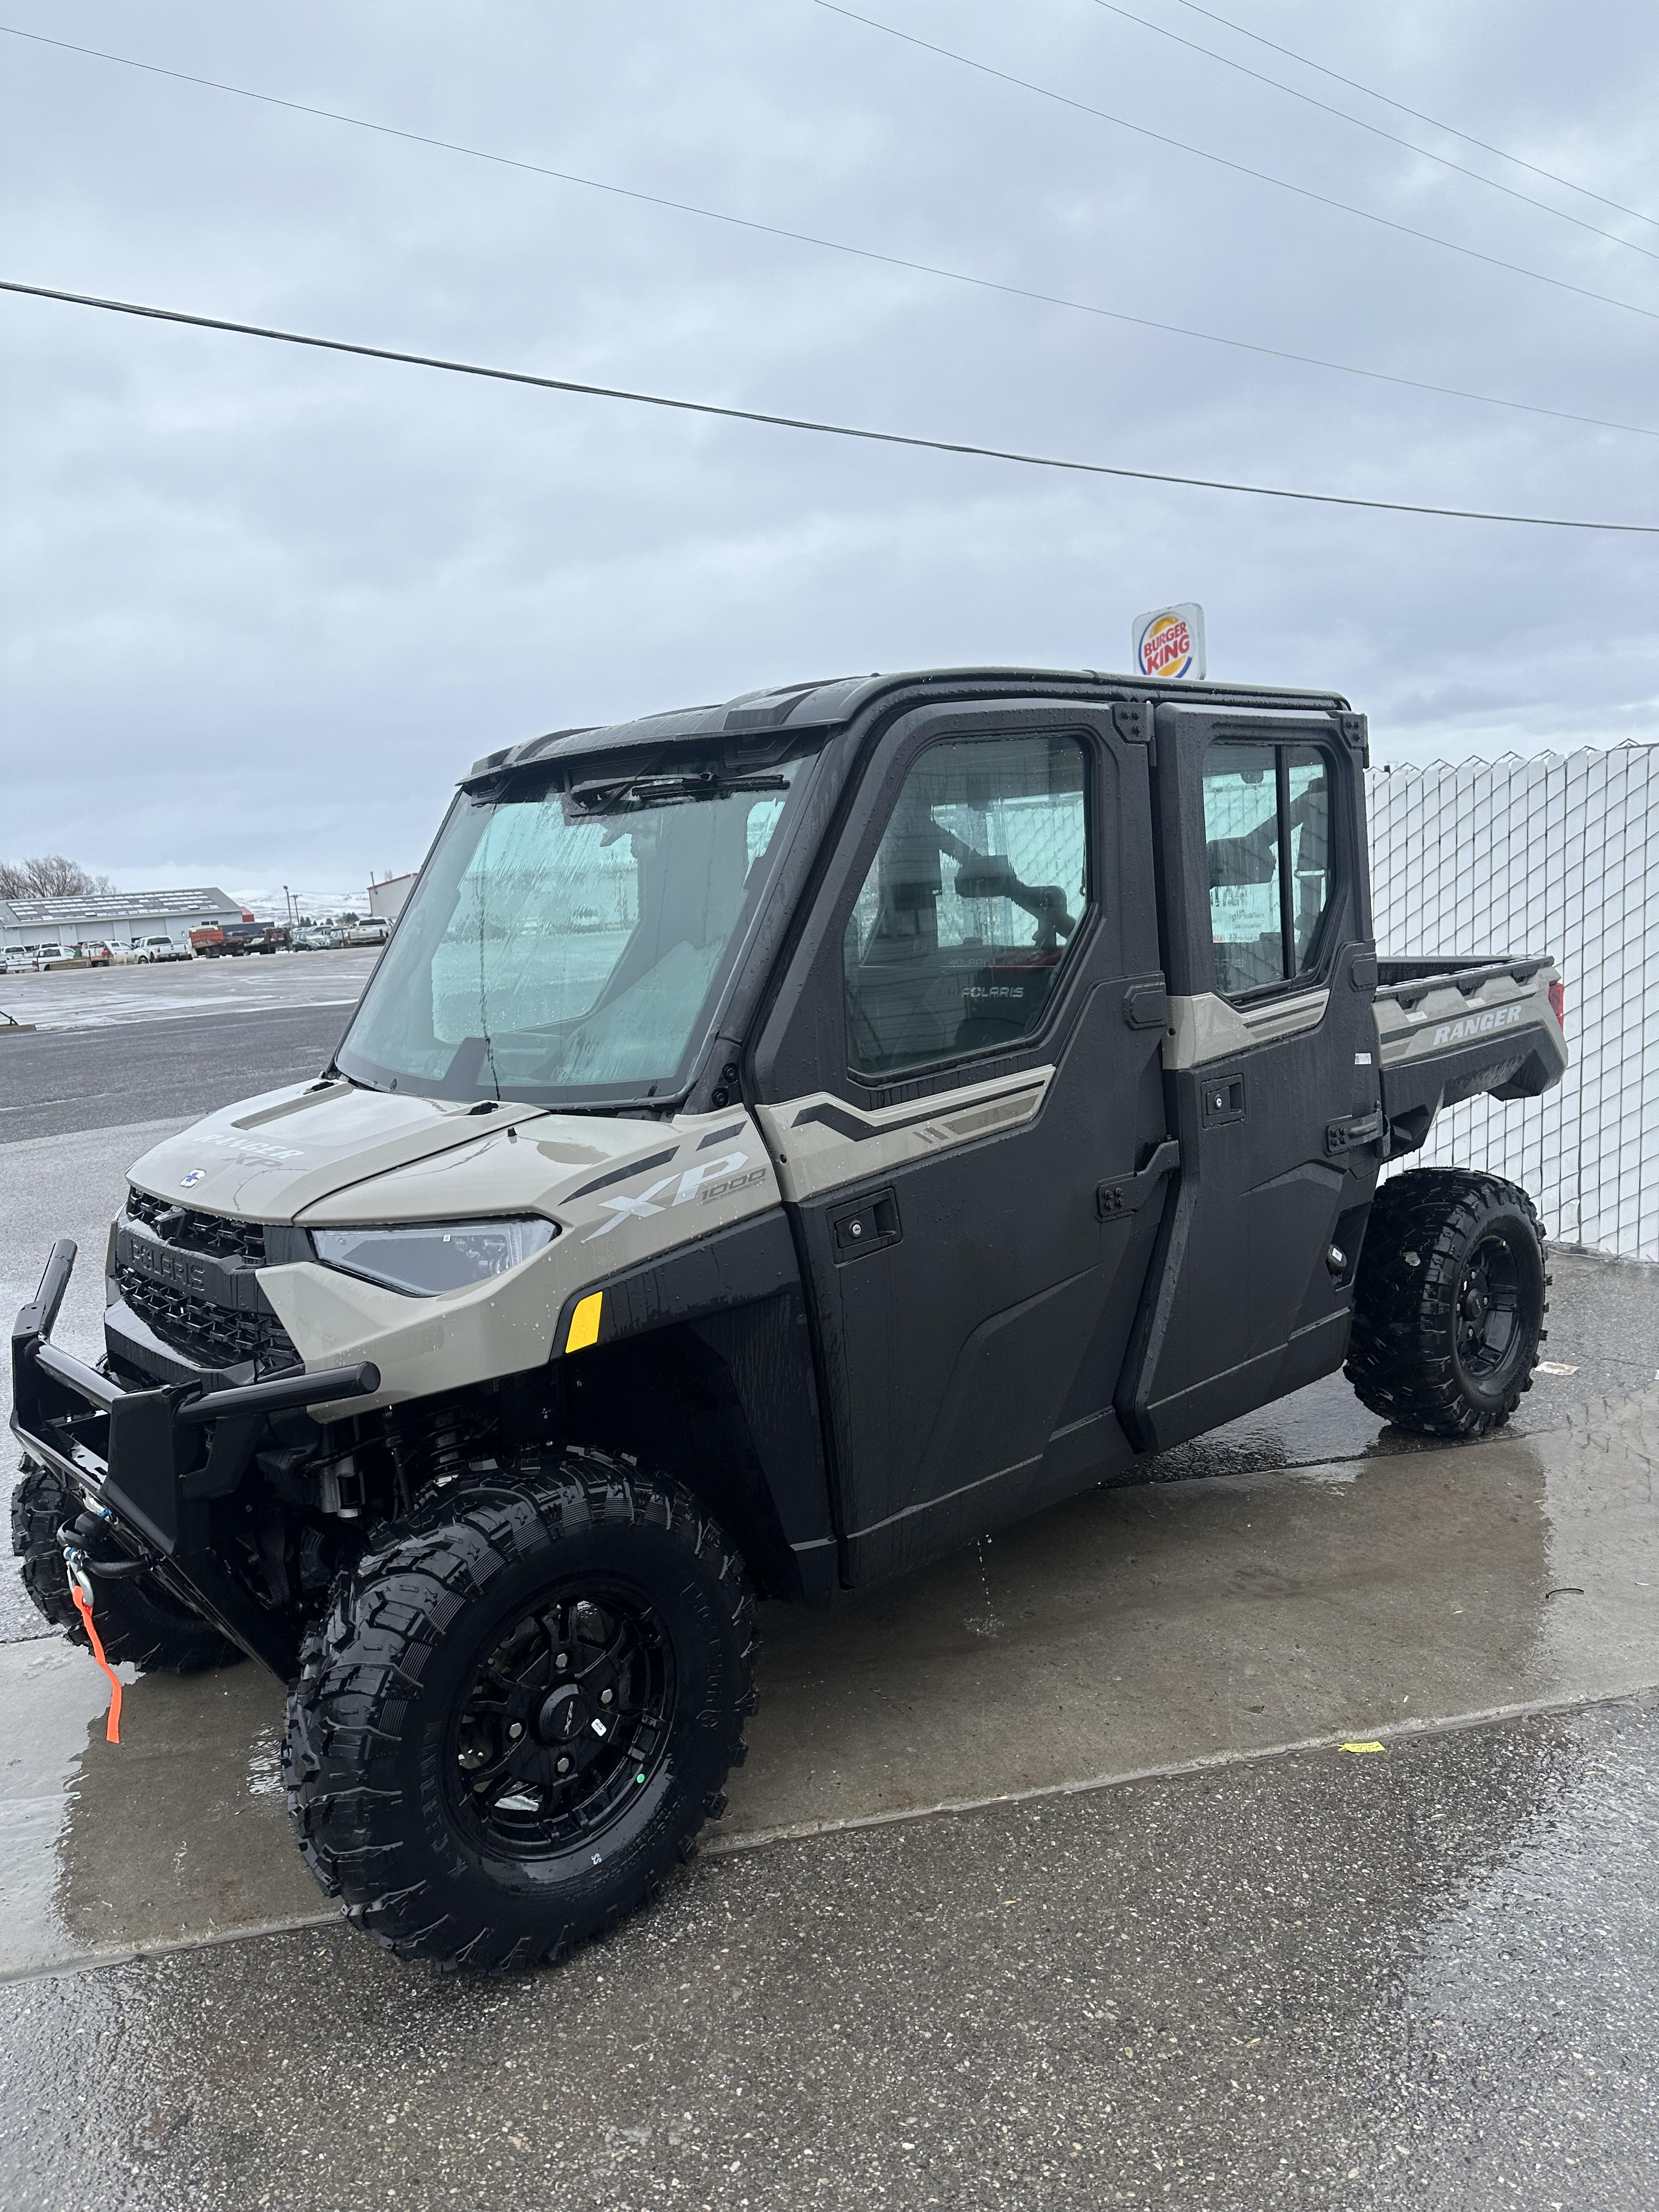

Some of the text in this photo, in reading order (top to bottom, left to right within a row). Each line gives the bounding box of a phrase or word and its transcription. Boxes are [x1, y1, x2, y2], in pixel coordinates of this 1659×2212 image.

[1144, 621, 1187, 658] BURGER
[1147, 634, 1190, 675] KING
[961, 986, 1024, 998] POLARIS
[1433, 1005, 1522, 1046] RANGER
[192, 1134, 306, 1159] RANGER
[583, 1151, 749, 1242] XP
[702, 1167, 766, 1200] 1000
[131, 1237, 205, 1291] POLARIS
[564, 1701, 573, 1735] XP
